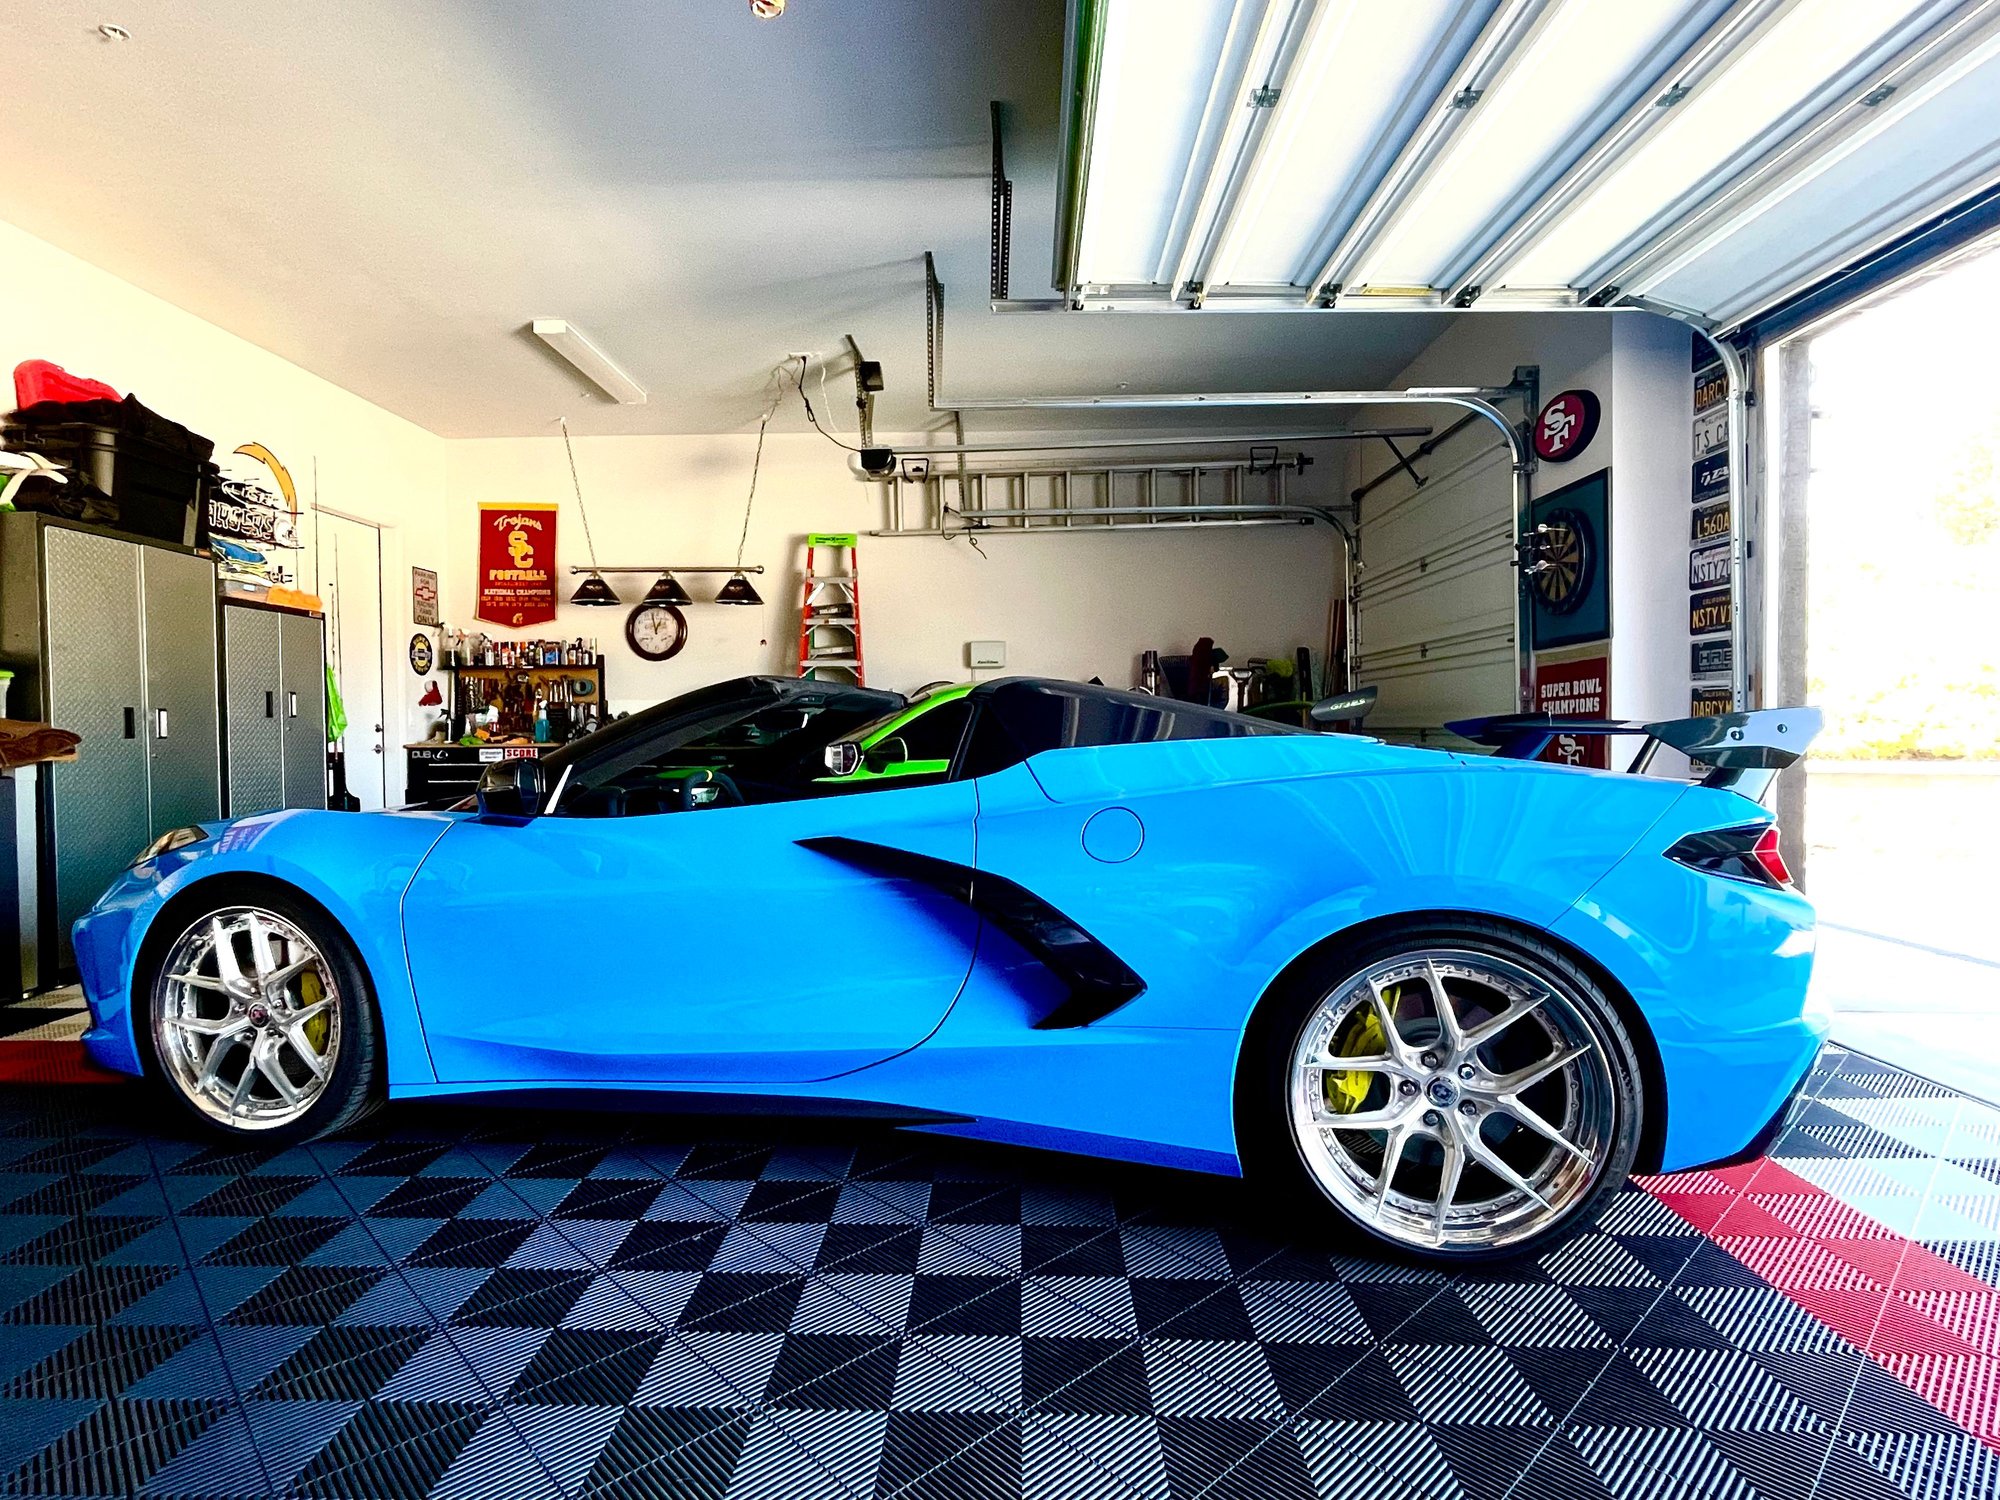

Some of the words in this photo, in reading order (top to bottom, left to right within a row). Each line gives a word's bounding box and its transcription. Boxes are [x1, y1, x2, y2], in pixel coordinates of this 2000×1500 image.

[1543, 400, 1575, 453] SF
[493, 513, 543, 531] Trojans
[1697, 511, 1730, 538] L560A
[508, 530, 534, 569] SC
[489, 569, 548, 581] FOOTBALL
[483, 588, 515, 596] NATIONAL
[416, 615, 435, 624] ONLY
[1692, 607, 1719, 629] NSTY
[1699, 648, 1732, 666] HRE
[1541, 682, 1571, 698] SUPER
[1573, 678, 1602, 695] BOWL
[1542, 697, 1600, 715] CHAMPIONS
[506, 749, 537, 758] SCORE
